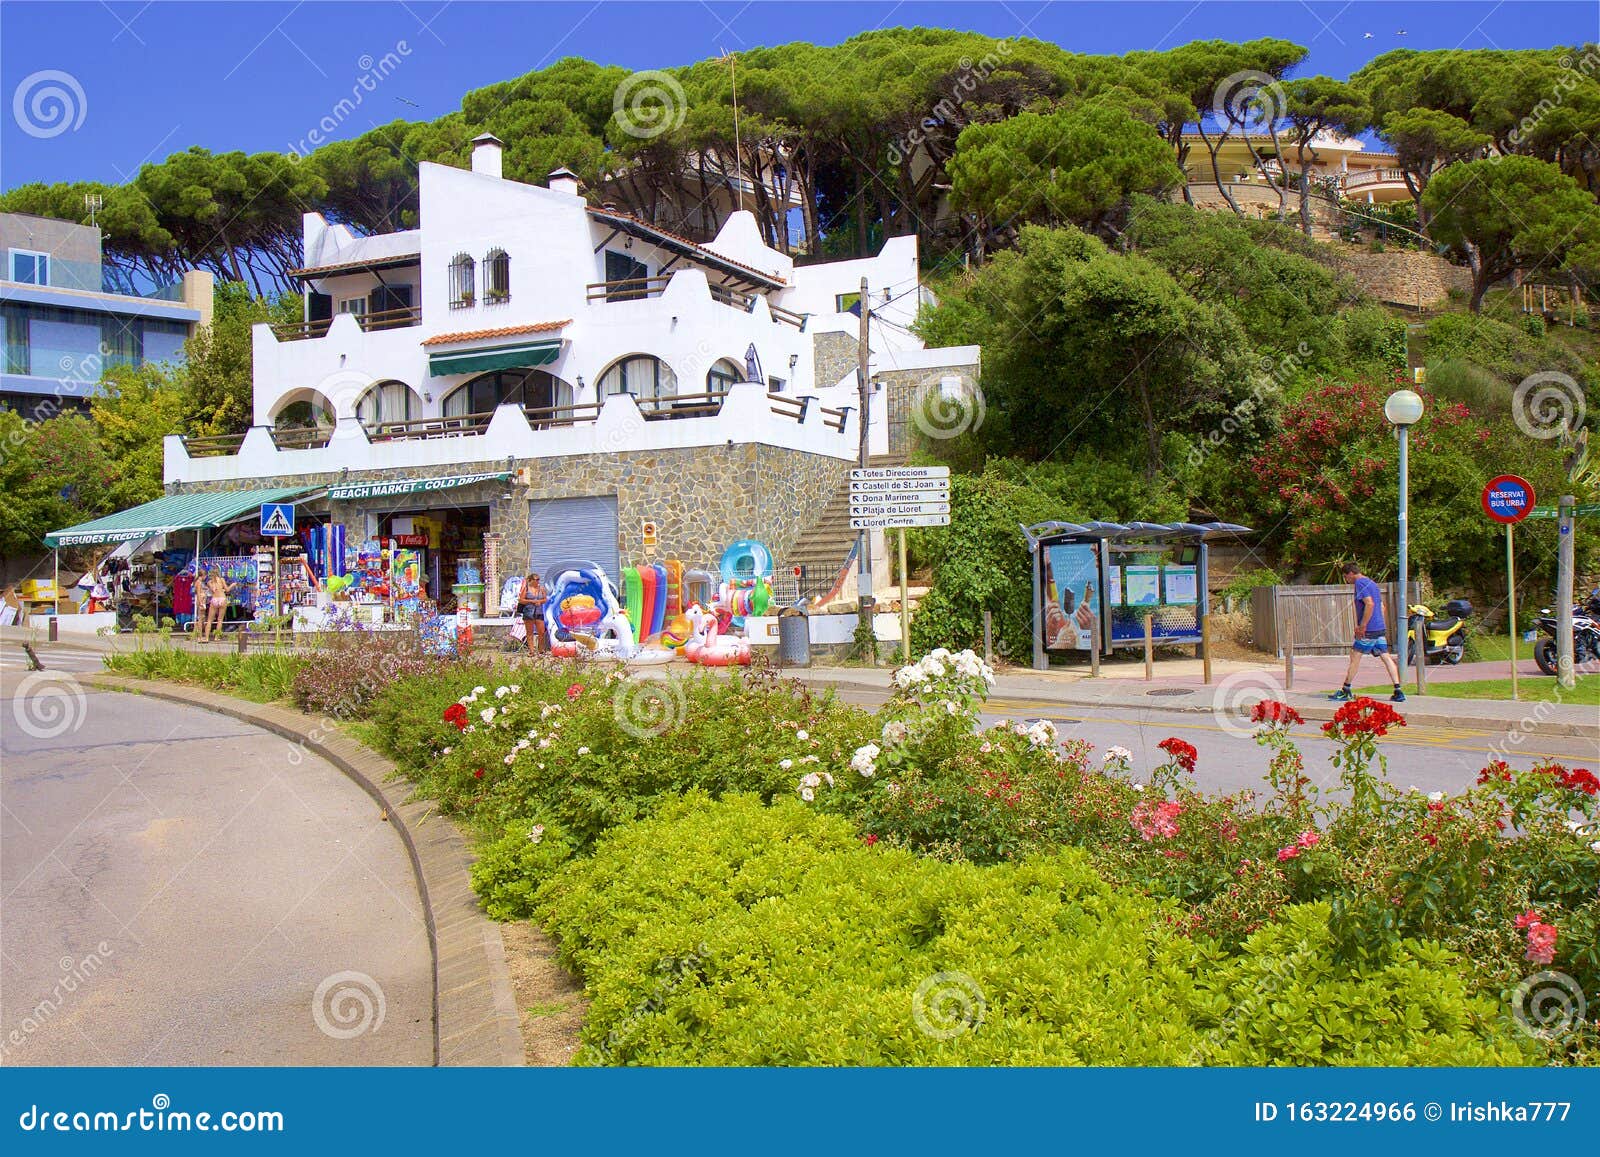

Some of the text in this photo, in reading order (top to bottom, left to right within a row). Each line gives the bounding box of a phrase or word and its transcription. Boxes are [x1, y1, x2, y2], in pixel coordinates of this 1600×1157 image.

[862, 469, 928, 478] Totes Direccions
[332, 487, 369, 499] BEACH
[371, 483, 417, 496] MARKET
[425, 478, 455, 490] COLD
[862, 482, 889, 490] Castell
[891, 481, 900, 489] de
[862, 493, 919, 502] Dona Marinera
[1490, 490, 1525, 499] RESERVAT
[862, 505, 922, 515] Platja de Lloret
[862, 519, 886, 527] Lloret
[59, 534, 105, 546] BEGUDES
[107, 531, 146, 542] FREDES
